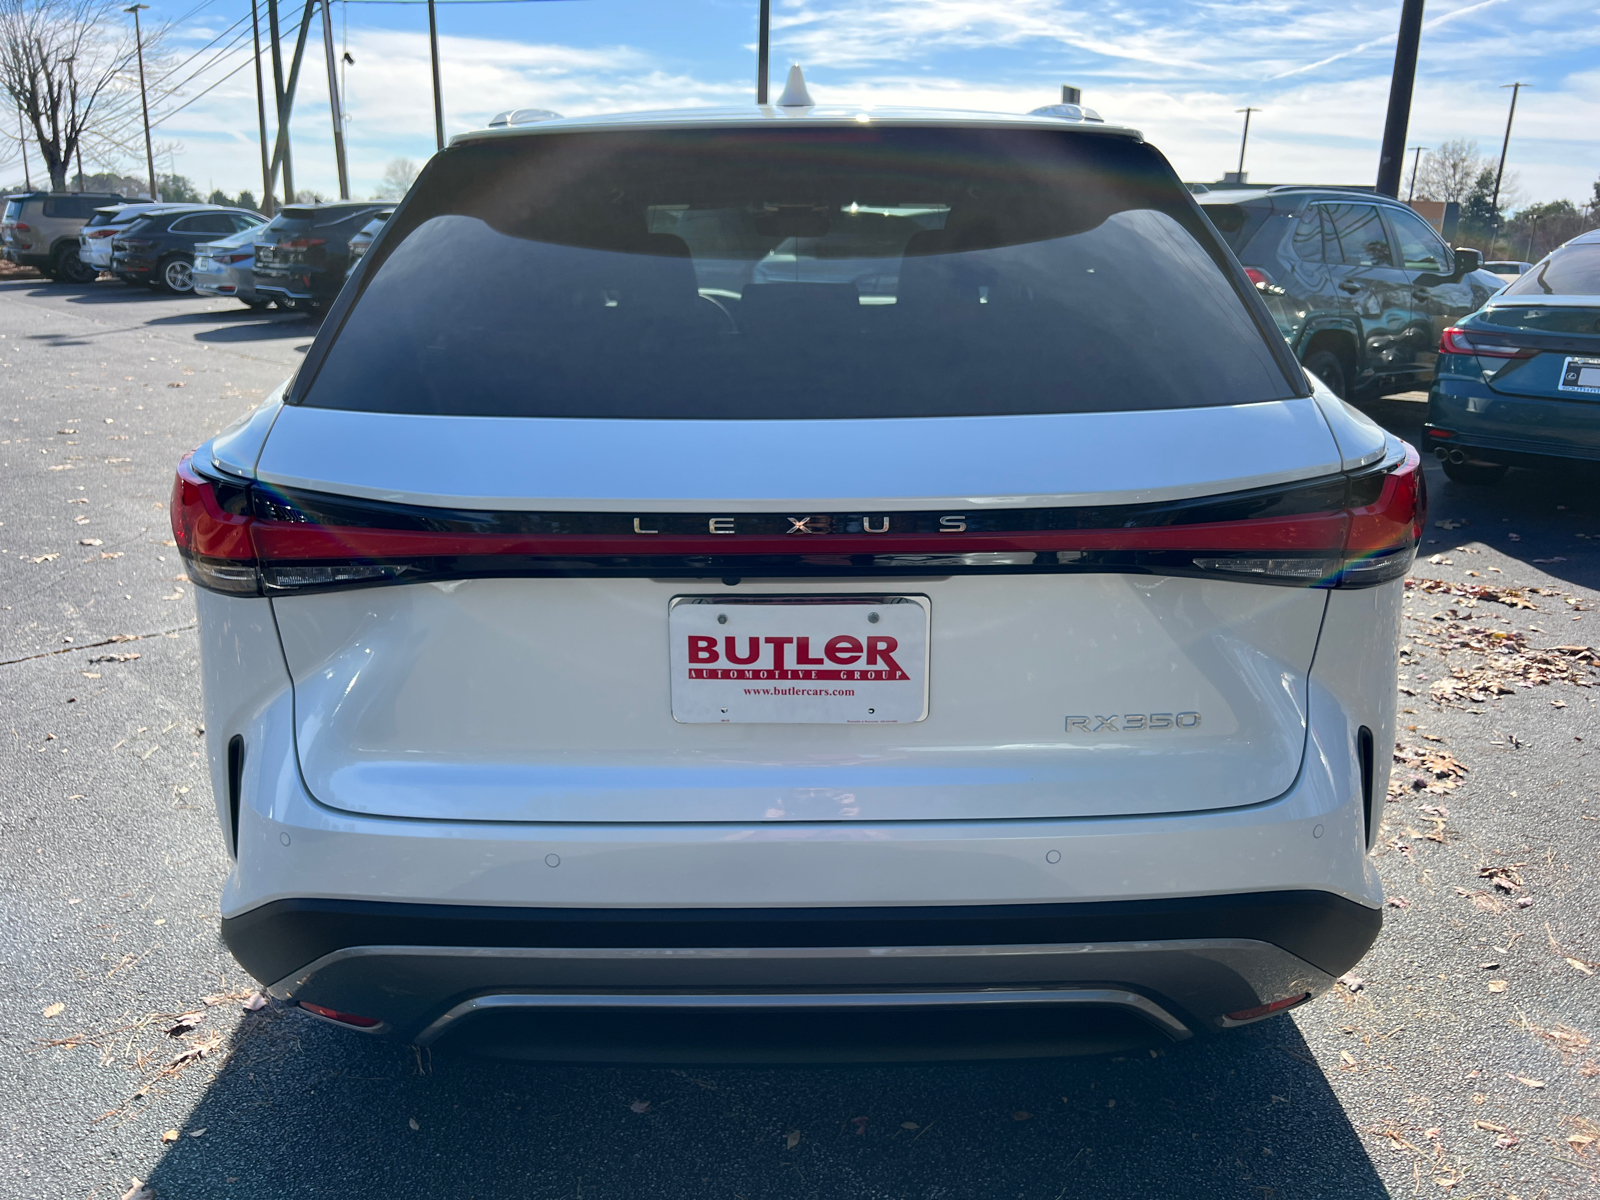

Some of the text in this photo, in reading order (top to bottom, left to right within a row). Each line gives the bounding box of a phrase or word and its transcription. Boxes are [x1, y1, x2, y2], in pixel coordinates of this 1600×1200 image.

[633, 515, 966, 534] LEXUS
[689, 669, 903, 680] AUTOMOTIVE GROUP
[743, 686, 856, 697] www.butlercars.com
[1065, 711, 1202, 733] RX350
